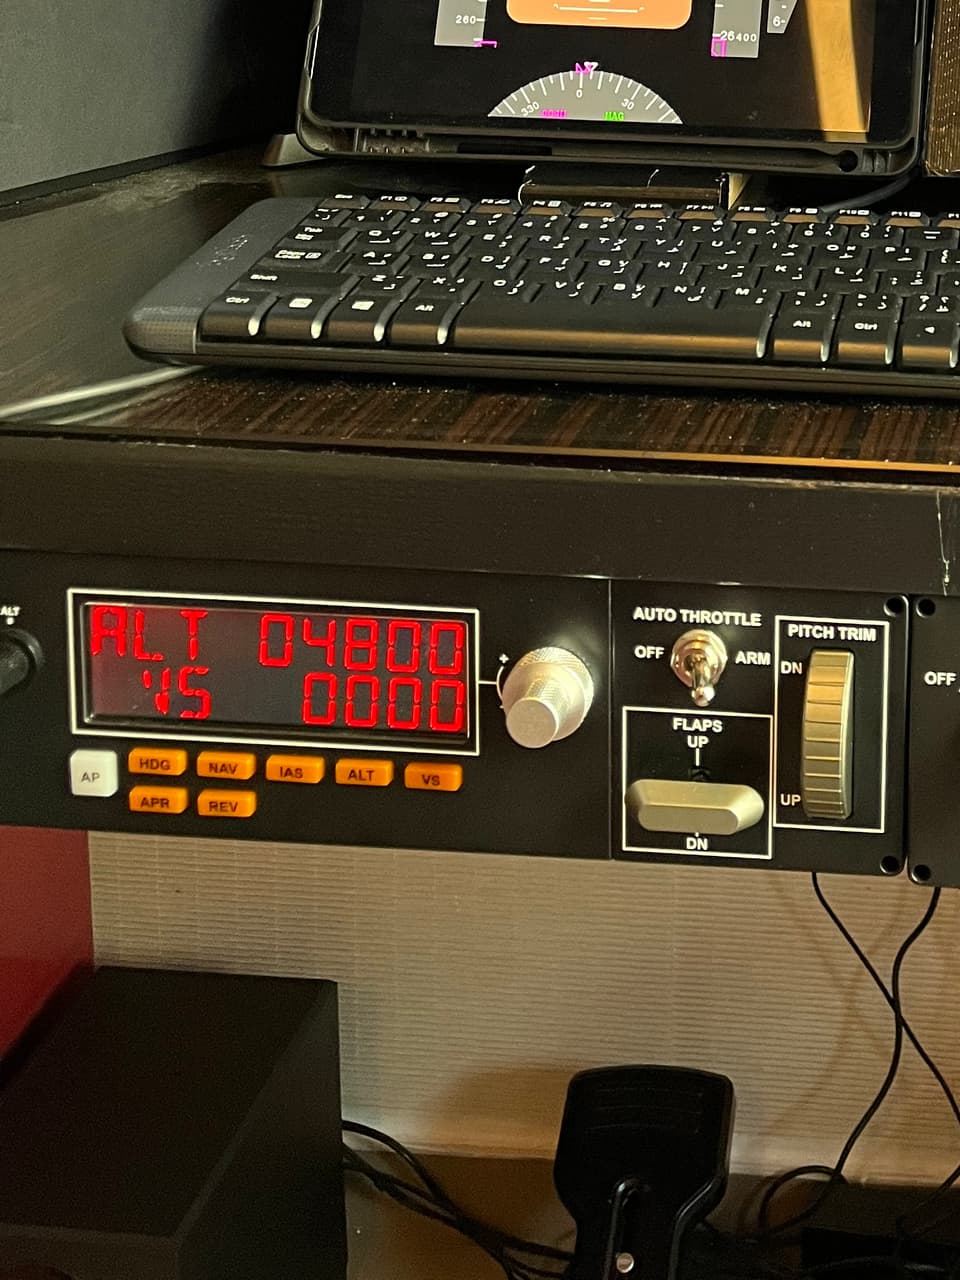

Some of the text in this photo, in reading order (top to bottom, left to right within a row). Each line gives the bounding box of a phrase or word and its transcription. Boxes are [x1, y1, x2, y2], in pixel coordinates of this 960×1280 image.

[456, 16, 476, 24] 260
[773, 16, 780, 26] 6
[720, 31, 757, 42] 26400
[576, 90, 582, 98] 0
[521, 101, 540, 116] 330
[622, 98, 634, 110] 30
[855, 323, 877, 331] Ctrl
[0, 606, 20, 617] ALT
[633, 606, 762, 628] AUTO THROTTLE
[91, 606, 465, 675] ALT 04800
[788, 624, 876, 642] PITCH TRIM
[634, 645, 665, 660] OFF
[735, 650, 771, 666] ARM
[780, 660, 803, 675] DN
[924, 671, 956, 687] OFF
[302, 671, 465, 732] 0000
[673, 717, 723, 734] FLAPS
[687, 735, 708, 750] UP
[138, 756, 172, 772] HDG
[208, 761, 238, 776] NAV
[80, 770, 100, 784] AP
[279, 765, 304, 780] IAS
[347, 767, 376, 782] ALT
[421, 773, 441, 787] VS
[139, 795, 171, 809] APR
[208, 799, 238, 813] REV
[780, 793, 801, 807] UP
[686, 836, 708, 851] DN
